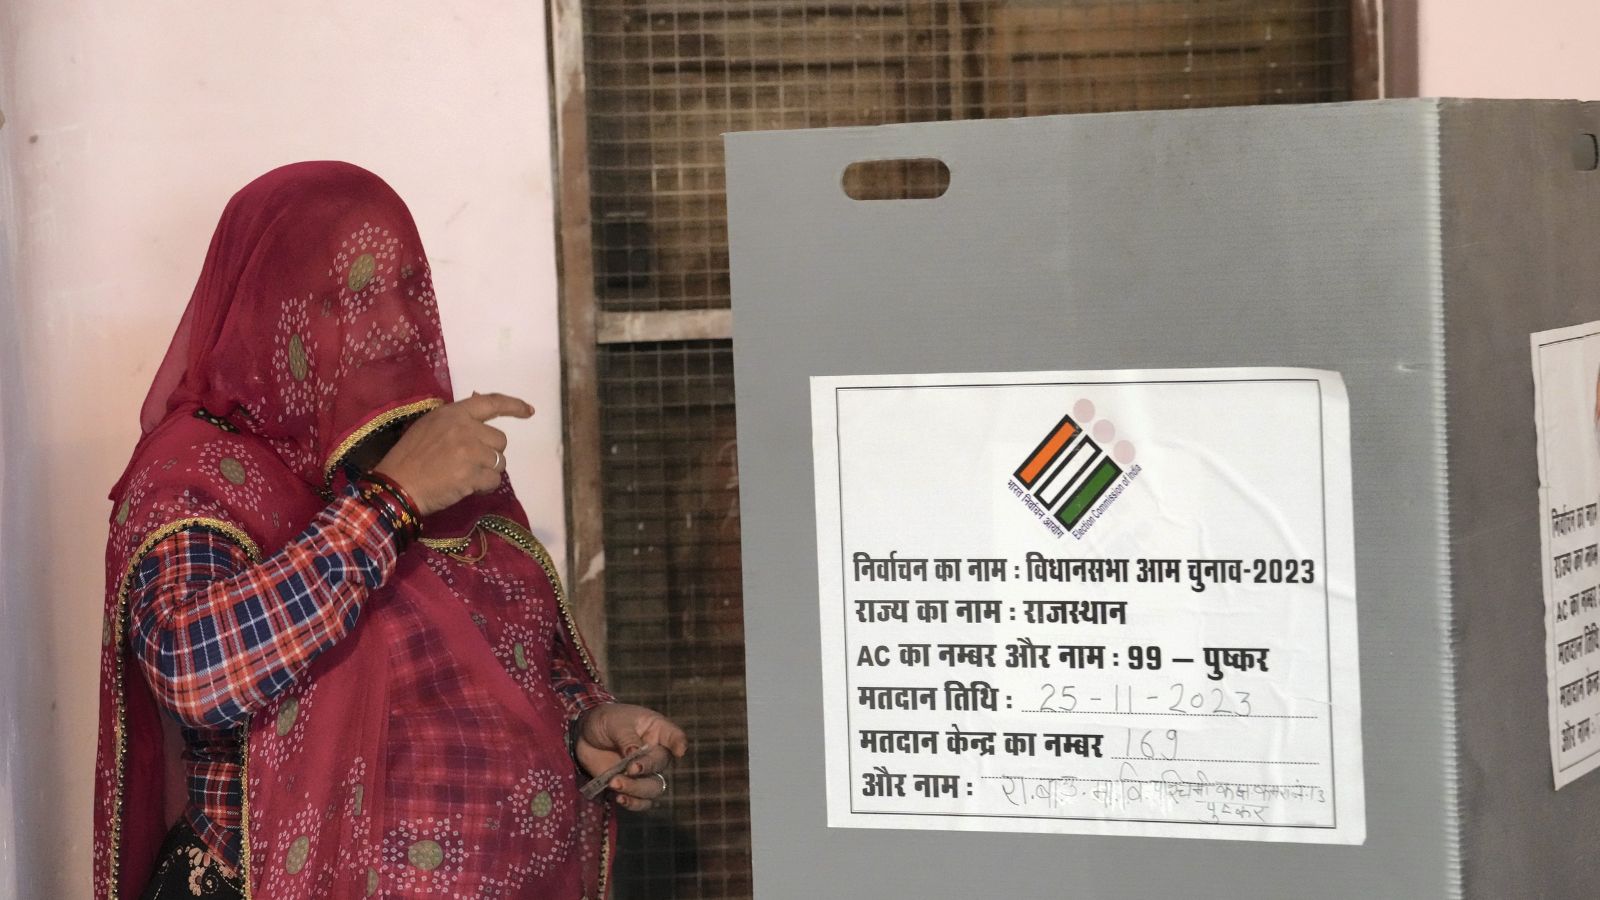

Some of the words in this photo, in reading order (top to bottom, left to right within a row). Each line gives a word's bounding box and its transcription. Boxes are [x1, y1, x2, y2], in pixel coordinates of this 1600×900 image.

[1007, 478, 1024, 498] भारत
[1021, 492, 1046, 520] निर्वाचन
[1042, 516, 1065, 540] आयोग
[1071, 516, 1094, 540] Election
[1091, 483, 1125, 519] Commission
[1127, 463, 1143, 482] India
[852, 550, 929, 582] निर्वाचन
[933, 557, 962, 582] का
[967, 557, 1008, 582] नाम
[1025, 551, 1130, 583] विधानसभा
[1136, 557, 1182, 584] आम
[1186, 557, 1315, 593] चुनाव-2023
[854, 599, 907, 623] राज्य
[915, 599, 949, 624] का
[954, 599, 1003, 624] नाम
[1022, 600, 1128, 625] राजस्थान
[857, 645, 891, 667] AC
[898, 643, 932, 667] का
[937, 643, 997, 668] नम्बर
[1005, 637, 1052, 669] और
[1057, 644, 1107, 670] नाम
[1127, 645, 1163, 671] 99
[1202, 647, 1270, 681] पुष्कर
[857, 686, 938, 711] मतदान
[944, 680, 1000, 712] तिथि
[859, 729, 939, 755] मतदान
[946, 723, 997, 757] केन्द्र
[1003, 732, 1037, 757] का
[1043, 732, 1104, 758] नम्बर
[1126, 728, 1177, 761] 169
[862, 766, 907, 798] और
[913, 774, 960, 799] नाम
